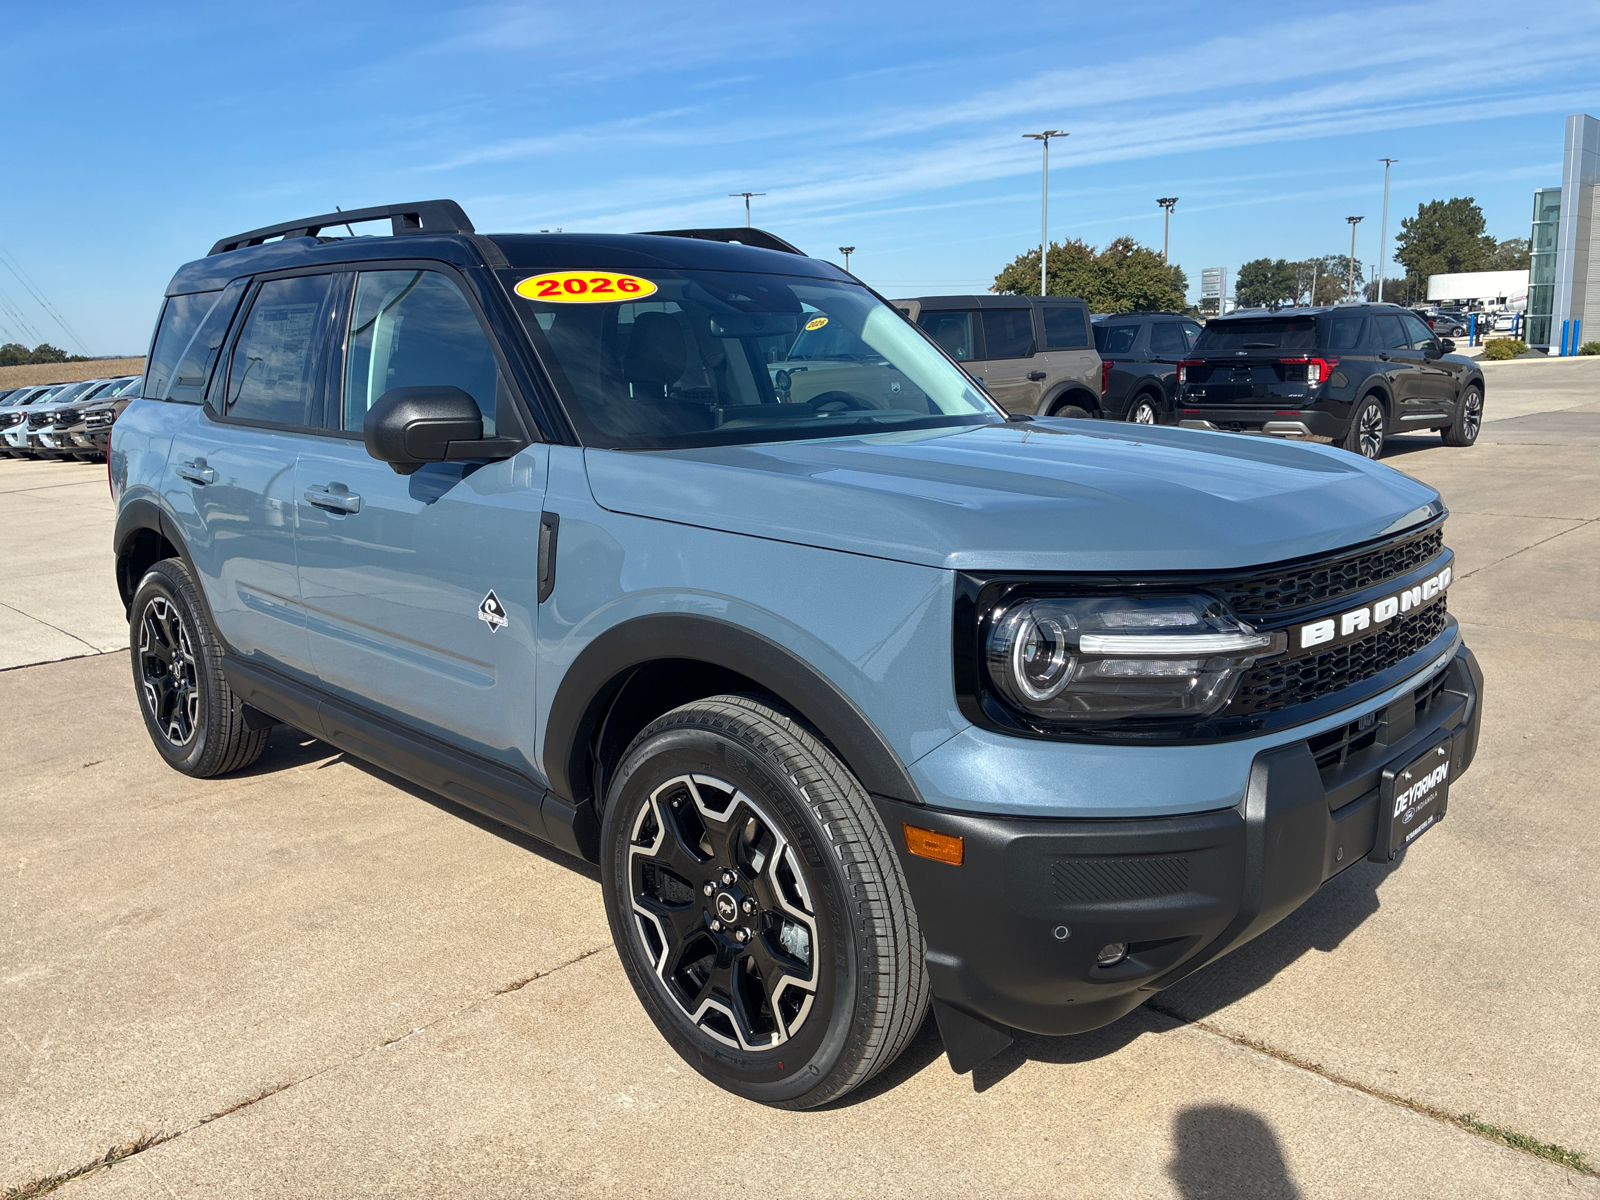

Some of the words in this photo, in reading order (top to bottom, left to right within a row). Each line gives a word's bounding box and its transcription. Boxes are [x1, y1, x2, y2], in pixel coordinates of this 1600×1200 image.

[536, 278, 641, 297] 2026
[1301, 567, 1451, 648] BRONCO
[749, 769, 821, 862] MICHELIN
[1393, 761, 1449, 818] DEYARMAN
